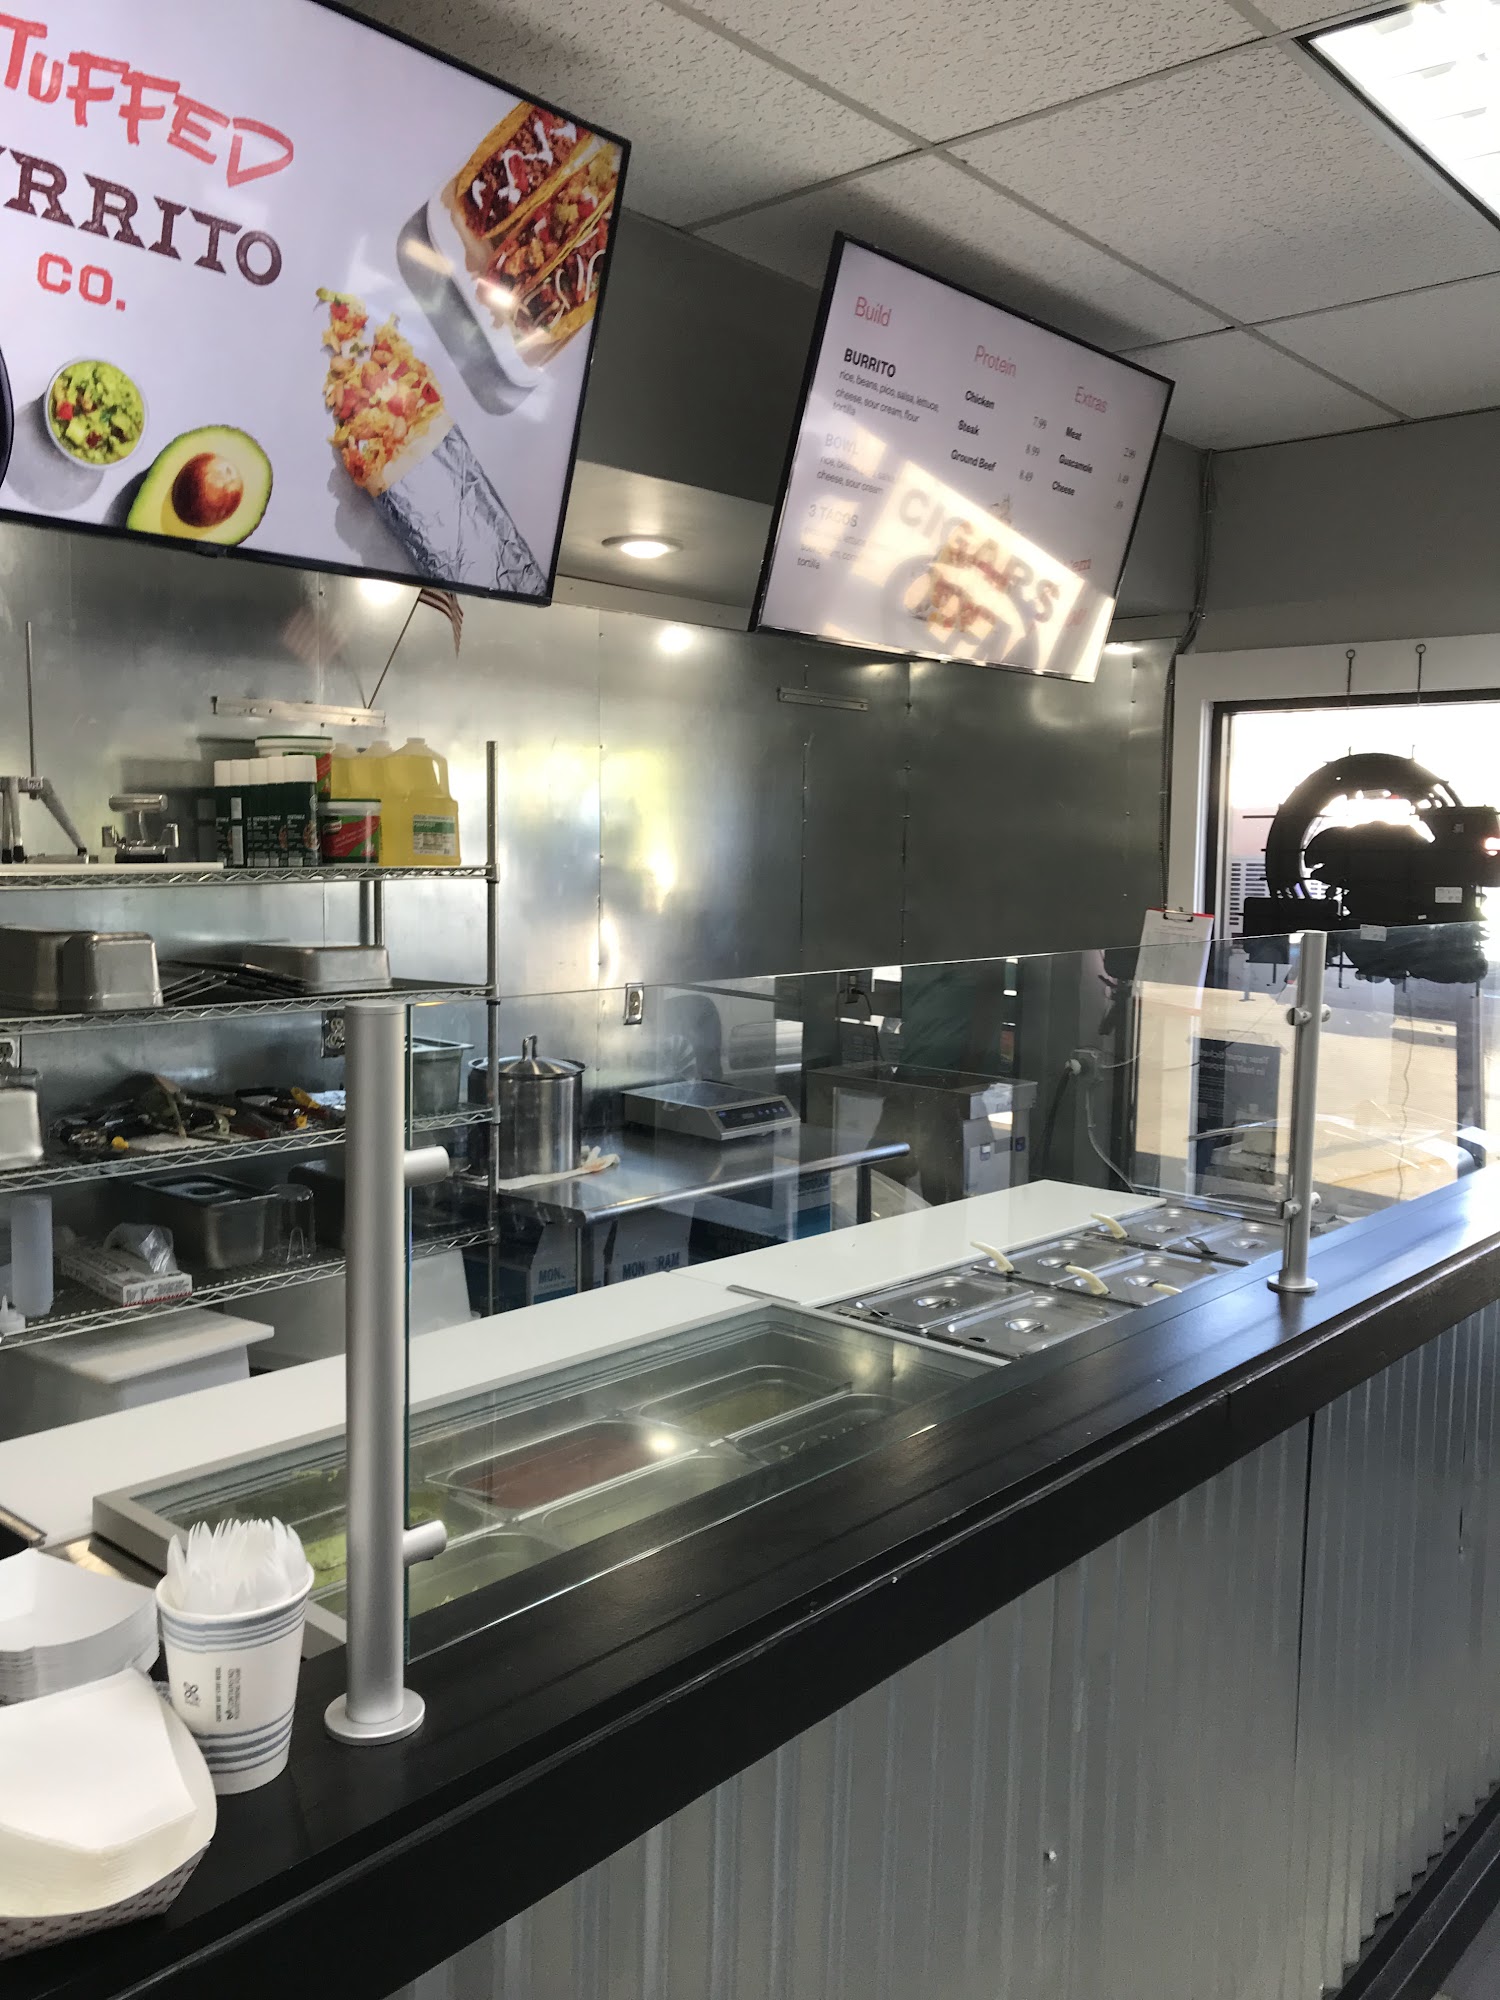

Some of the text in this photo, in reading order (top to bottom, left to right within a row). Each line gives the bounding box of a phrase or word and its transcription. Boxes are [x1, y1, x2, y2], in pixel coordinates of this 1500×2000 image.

[0, 144, 283, 287] RRITO
[37, 252, 126, 312] CO.
[854, 296, 892, 327] Build
[843, 347, 897, 378] BURRITO
[974, 344, 1017, 377] Protein
[965, 390, 996, 410] Chicken
[1074, 385, 1108, 414] Extras
[958, 419, 980, 436] Steak
[1065, 426, 1082, 441] Meat
[950, 449, 979, 467] Ground
[978, 457, 997, 472] Beef
[1052, 480, 1076, 497] Cheese
[808, 503, 859, 528] 3 TACOS
